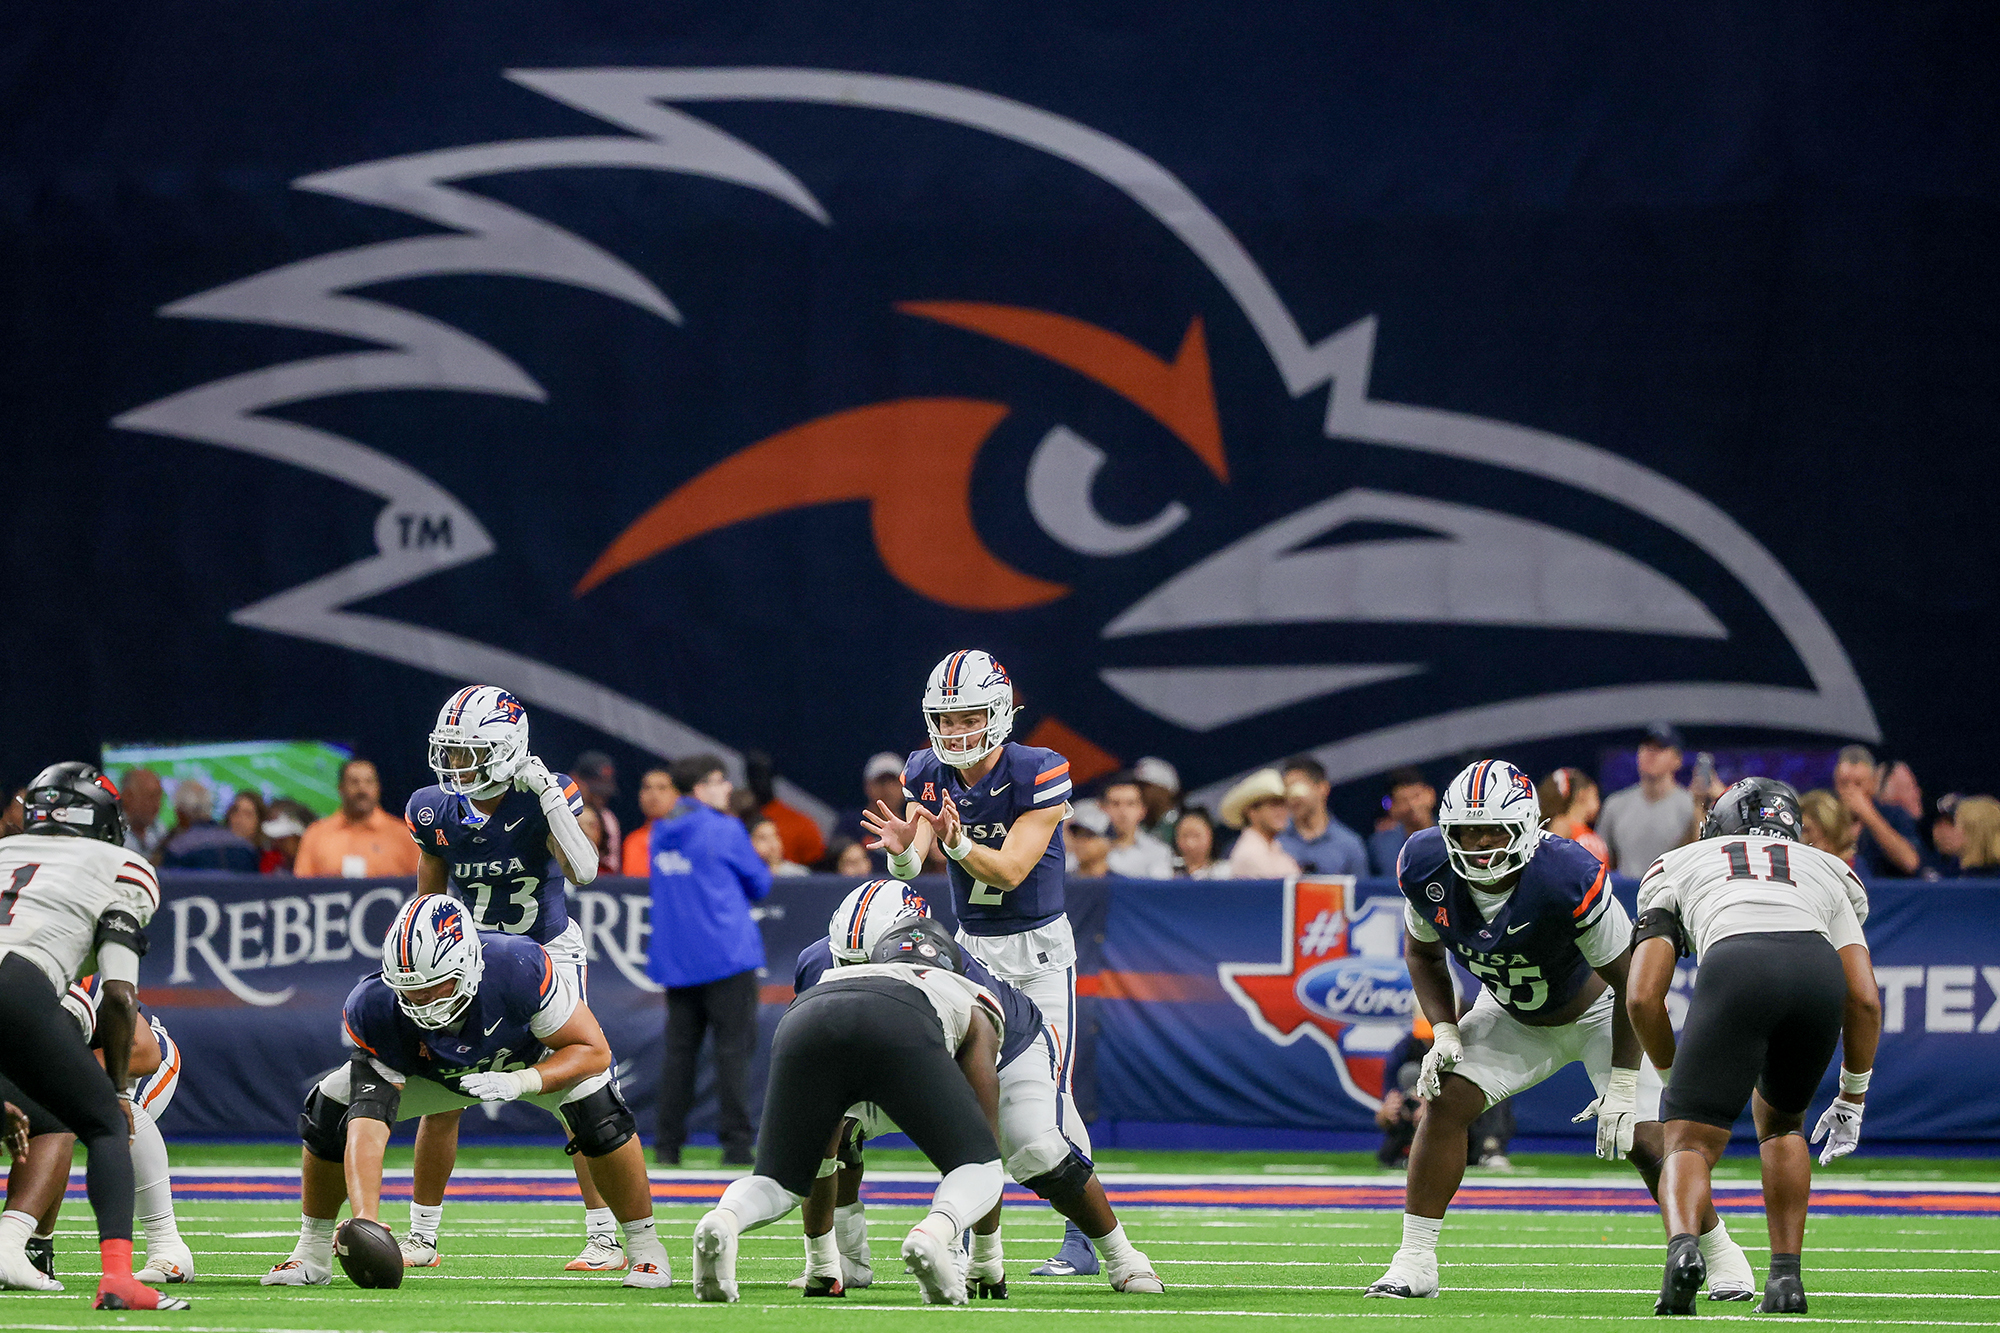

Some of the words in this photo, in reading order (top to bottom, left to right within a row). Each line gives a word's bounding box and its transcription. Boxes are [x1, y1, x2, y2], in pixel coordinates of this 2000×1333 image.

[396, 514, 453, 549] TM
[1465, 809, 1484, 818] 210
[454, 857, 526, 879] UTSA
[1721, 841, 1797, 888] 11
[467, 876, 541, 935] 13
[168, 887, 419, 1006] REBEC
[1457, 943, 1530, 966] UTSA
[1468, 959, 1549, 1012] 55
